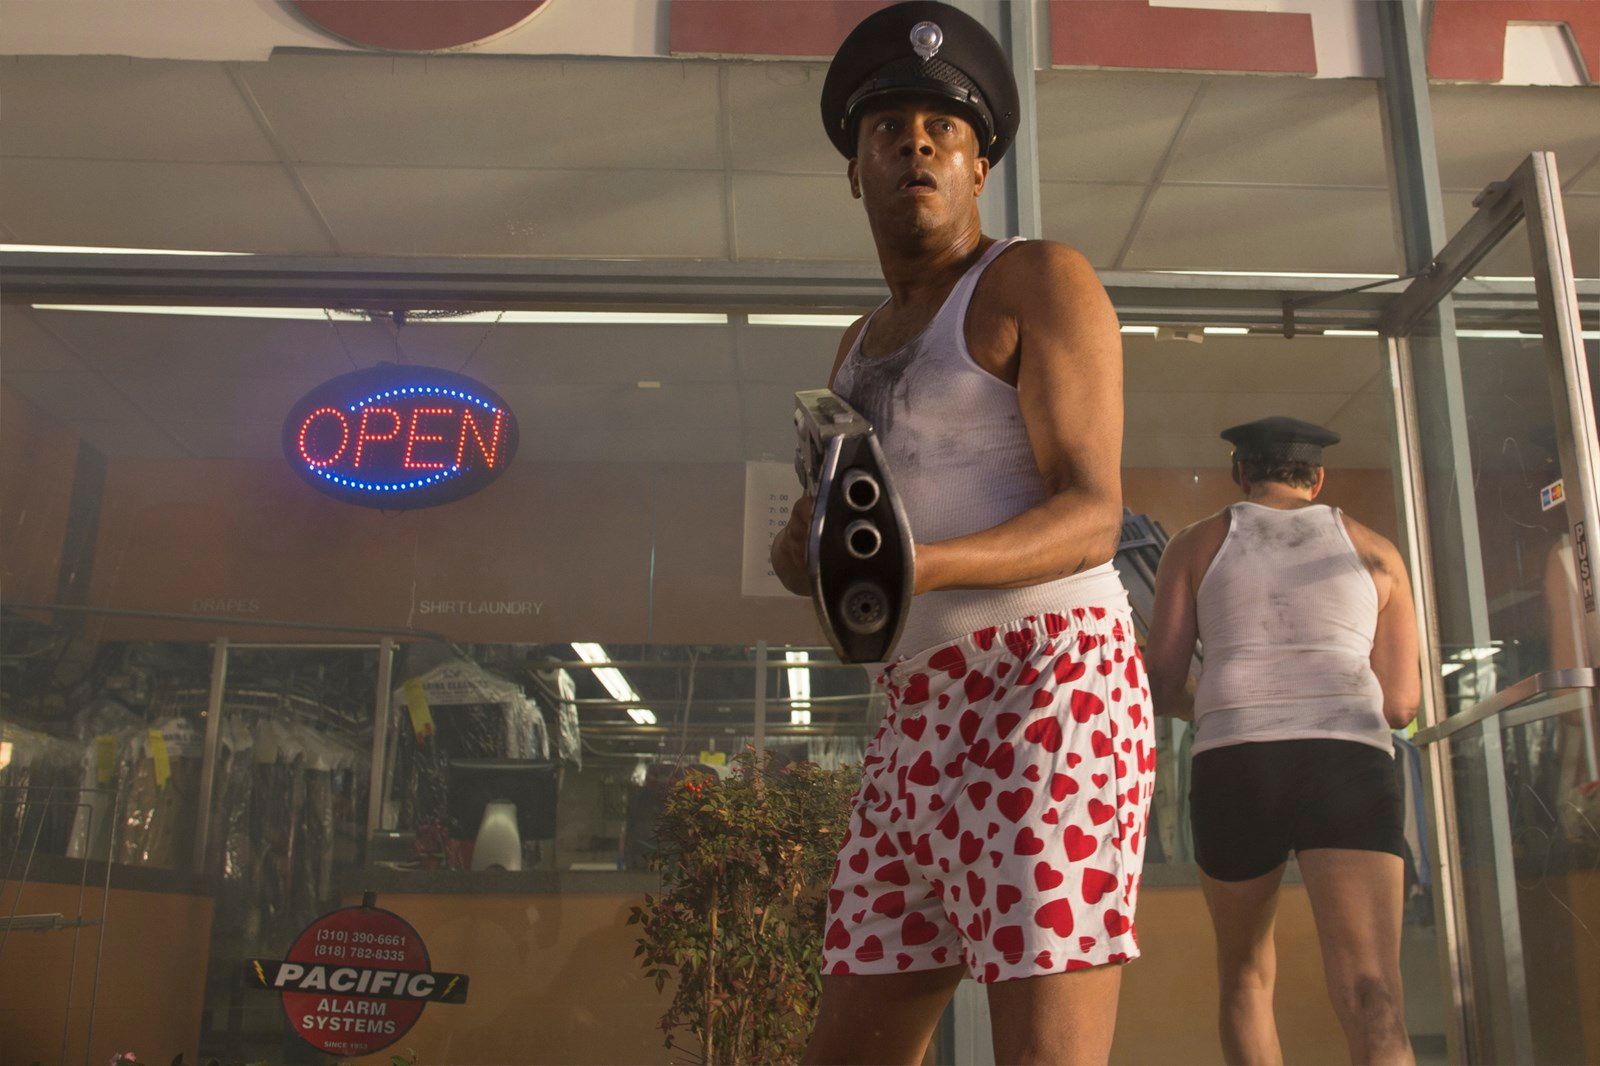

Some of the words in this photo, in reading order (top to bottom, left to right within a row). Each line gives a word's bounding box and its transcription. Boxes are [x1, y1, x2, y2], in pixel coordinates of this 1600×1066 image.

[298, 406, 503, 470] OPEN
[1575, 523, 1593, 598] PUSH
[192, 598, 260, 613] DRAPES
[419, 600, 466, 614] SHIRT
[467, 600, 544, 615] LAUNDRY
[317, 929, 348, 943] (310)
[314, 944, 346, 958] (818)
[274, 963, 435, 998] PACIFIC
[317, 998, 387, 1016] ALARM
[302, 1015, 396, 1034] SYSTEMS
[324, 1041, 347, 1049] SINCE
